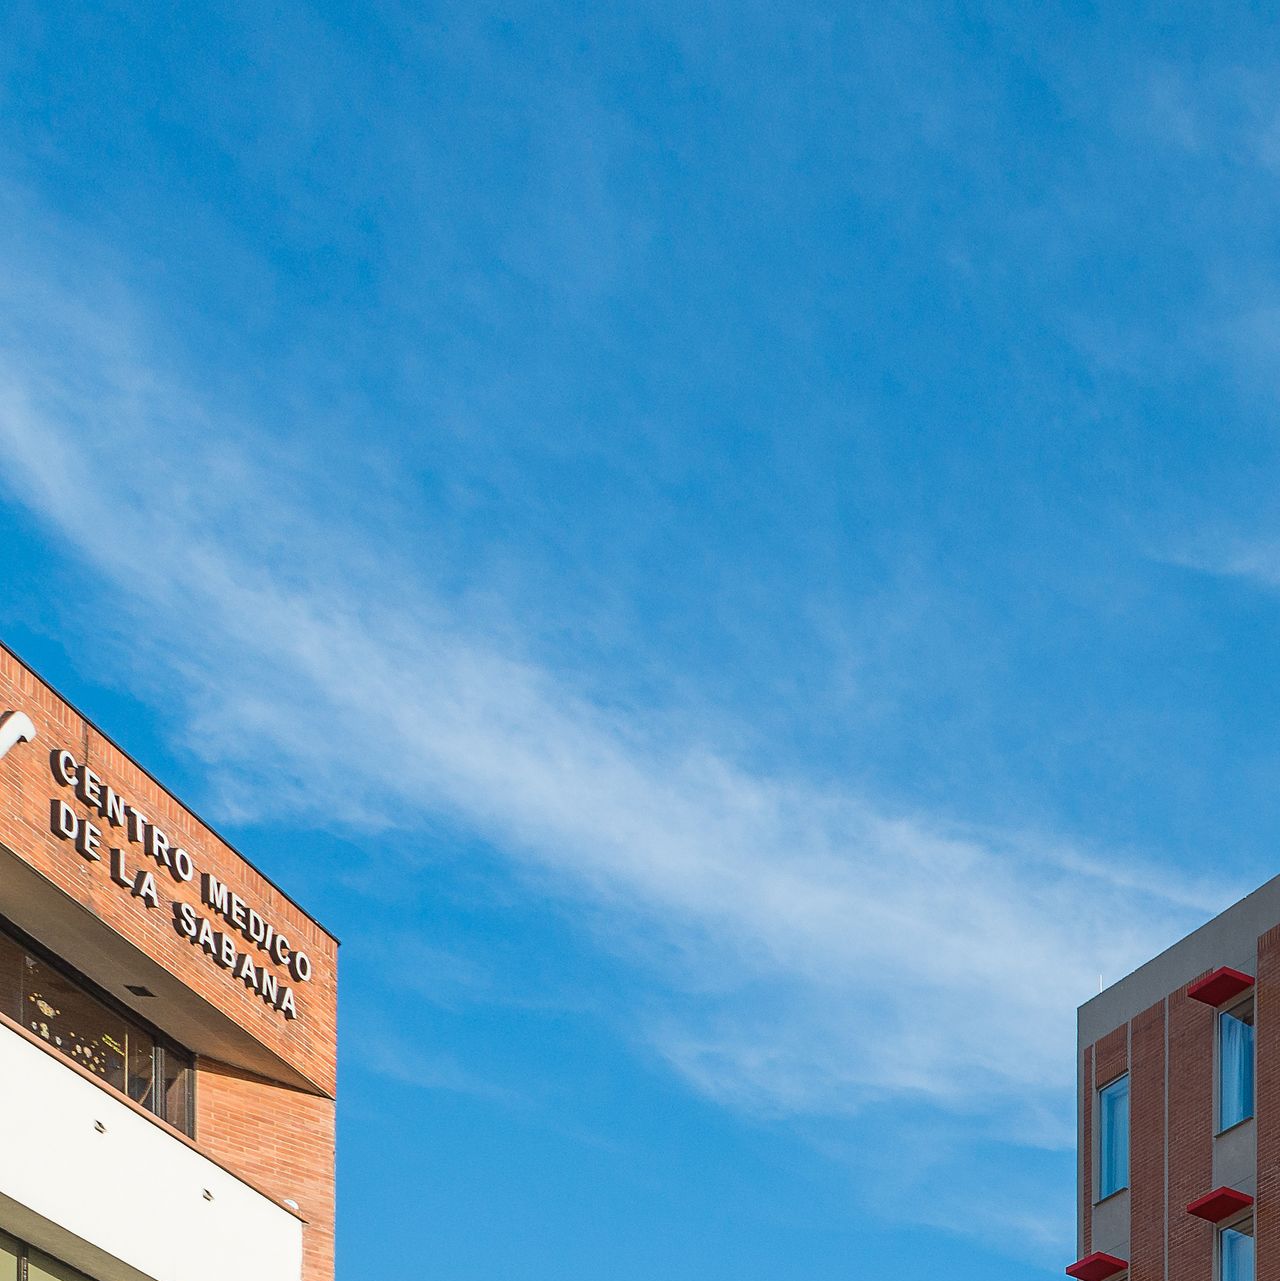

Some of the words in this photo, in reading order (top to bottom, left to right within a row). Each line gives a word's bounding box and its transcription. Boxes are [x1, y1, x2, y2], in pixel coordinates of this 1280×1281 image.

[53, 749, 194, 882] CENTRO
[204, 873, 312, 983] MEDICO
[54, 799, 101, 861] DE
[112, 849, 160, 908] LA
[174, 902, 298, 1020] SABANA
